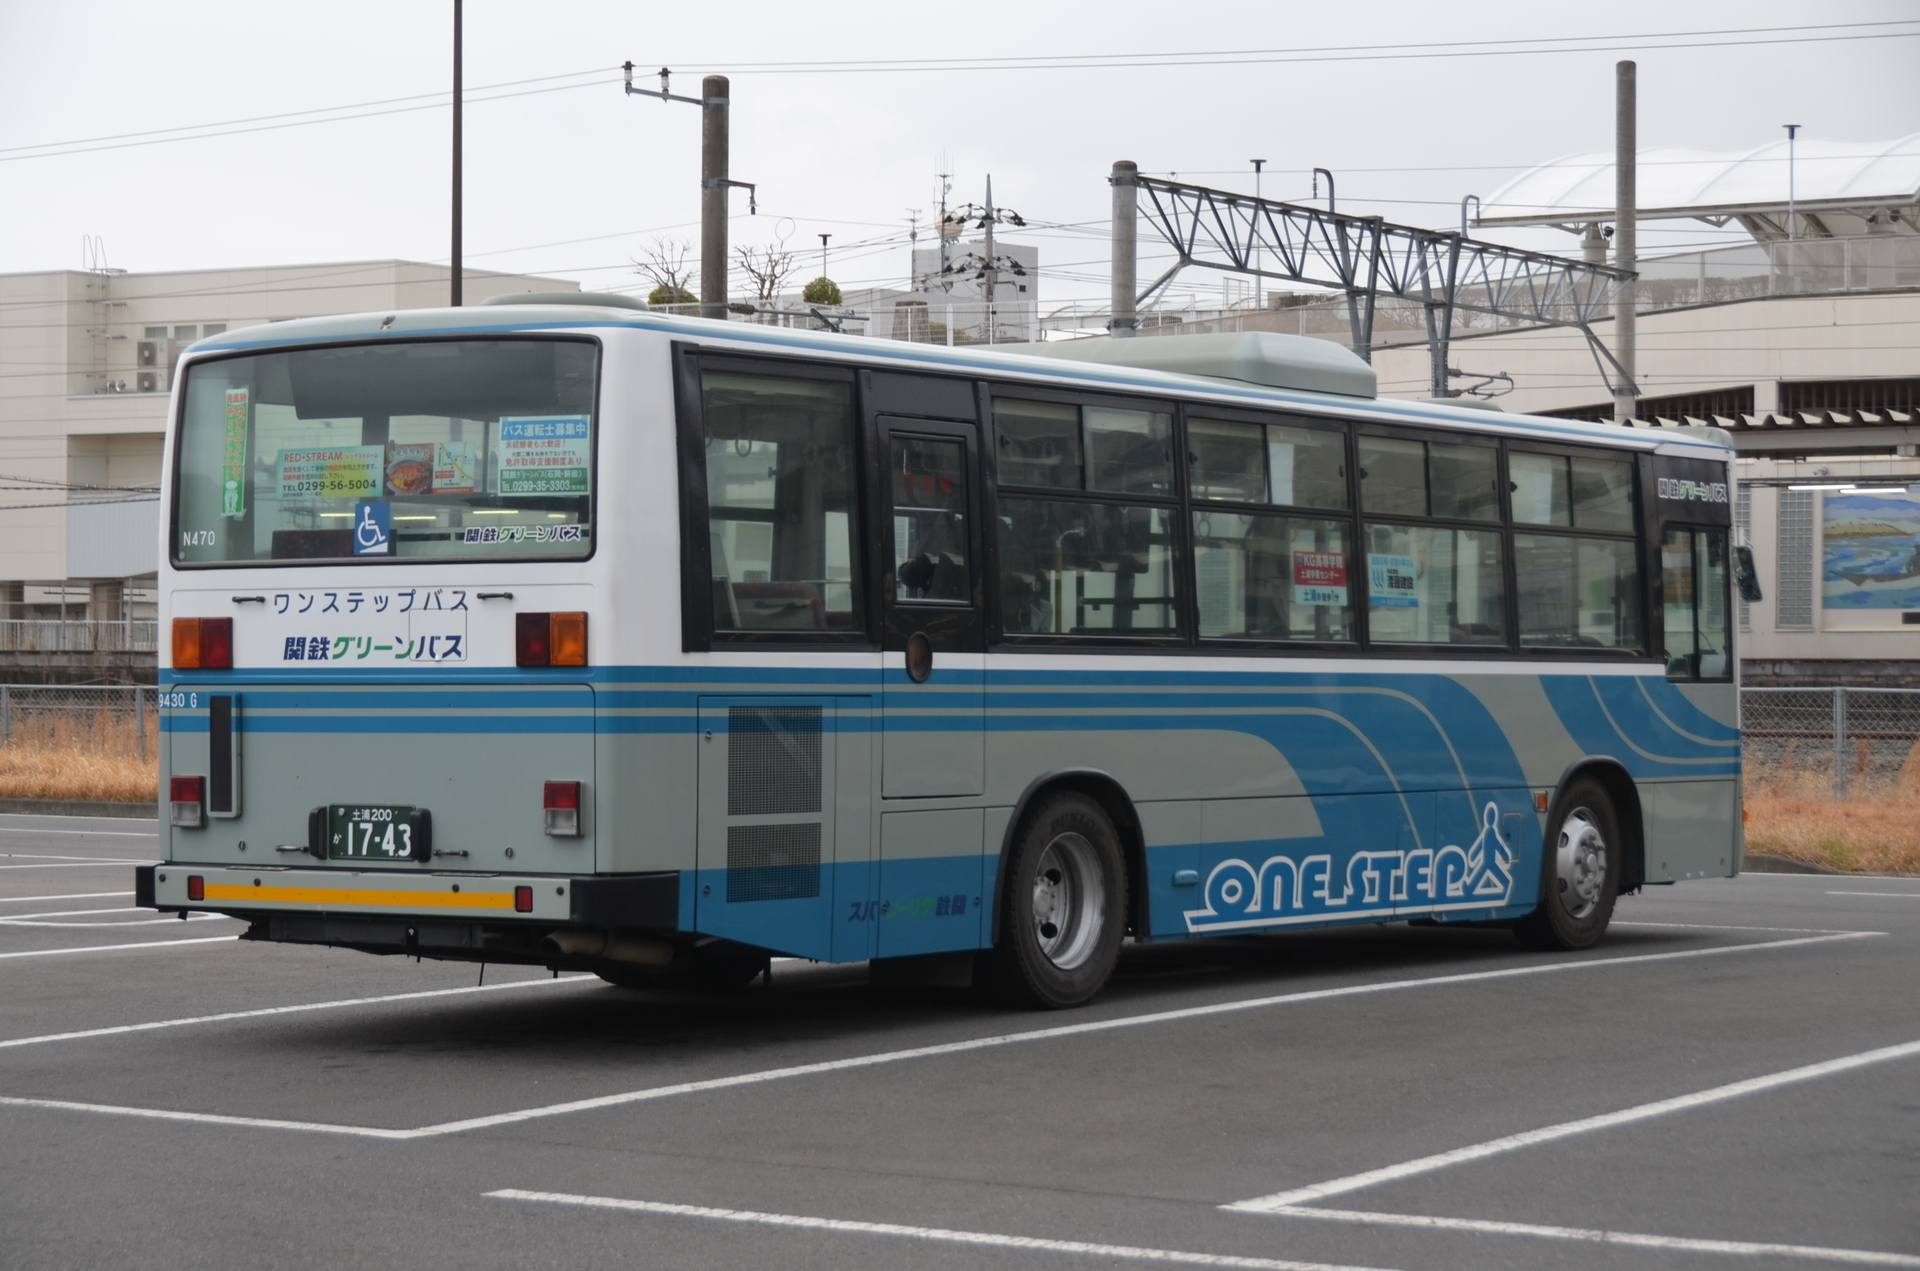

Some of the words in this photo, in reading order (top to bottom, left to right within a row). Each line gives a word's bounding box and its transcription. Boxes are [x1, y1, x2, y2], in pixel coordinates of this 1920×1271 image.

[503, 423, 586, 436] バス運転士募集中
[505, 457, 582, 467] 免許取得支援制度あり
[297, 480, 377, 491] 0299-56-5004
[1658, 477, 1728, 503] 関鉄グリーンバス
[183, 530, 216, 547] N470
[464, 524, 581, 544] 関鉄グリーンバス
[274, 589, 470, 613] ワンステップバス
[283, 634, 463, 660] 関鉄グリーンバス
[190, 692, 197, 708] G
[1204, 853, 1347, 914] ONE
[1346, 844, 1468, 903] STEP
